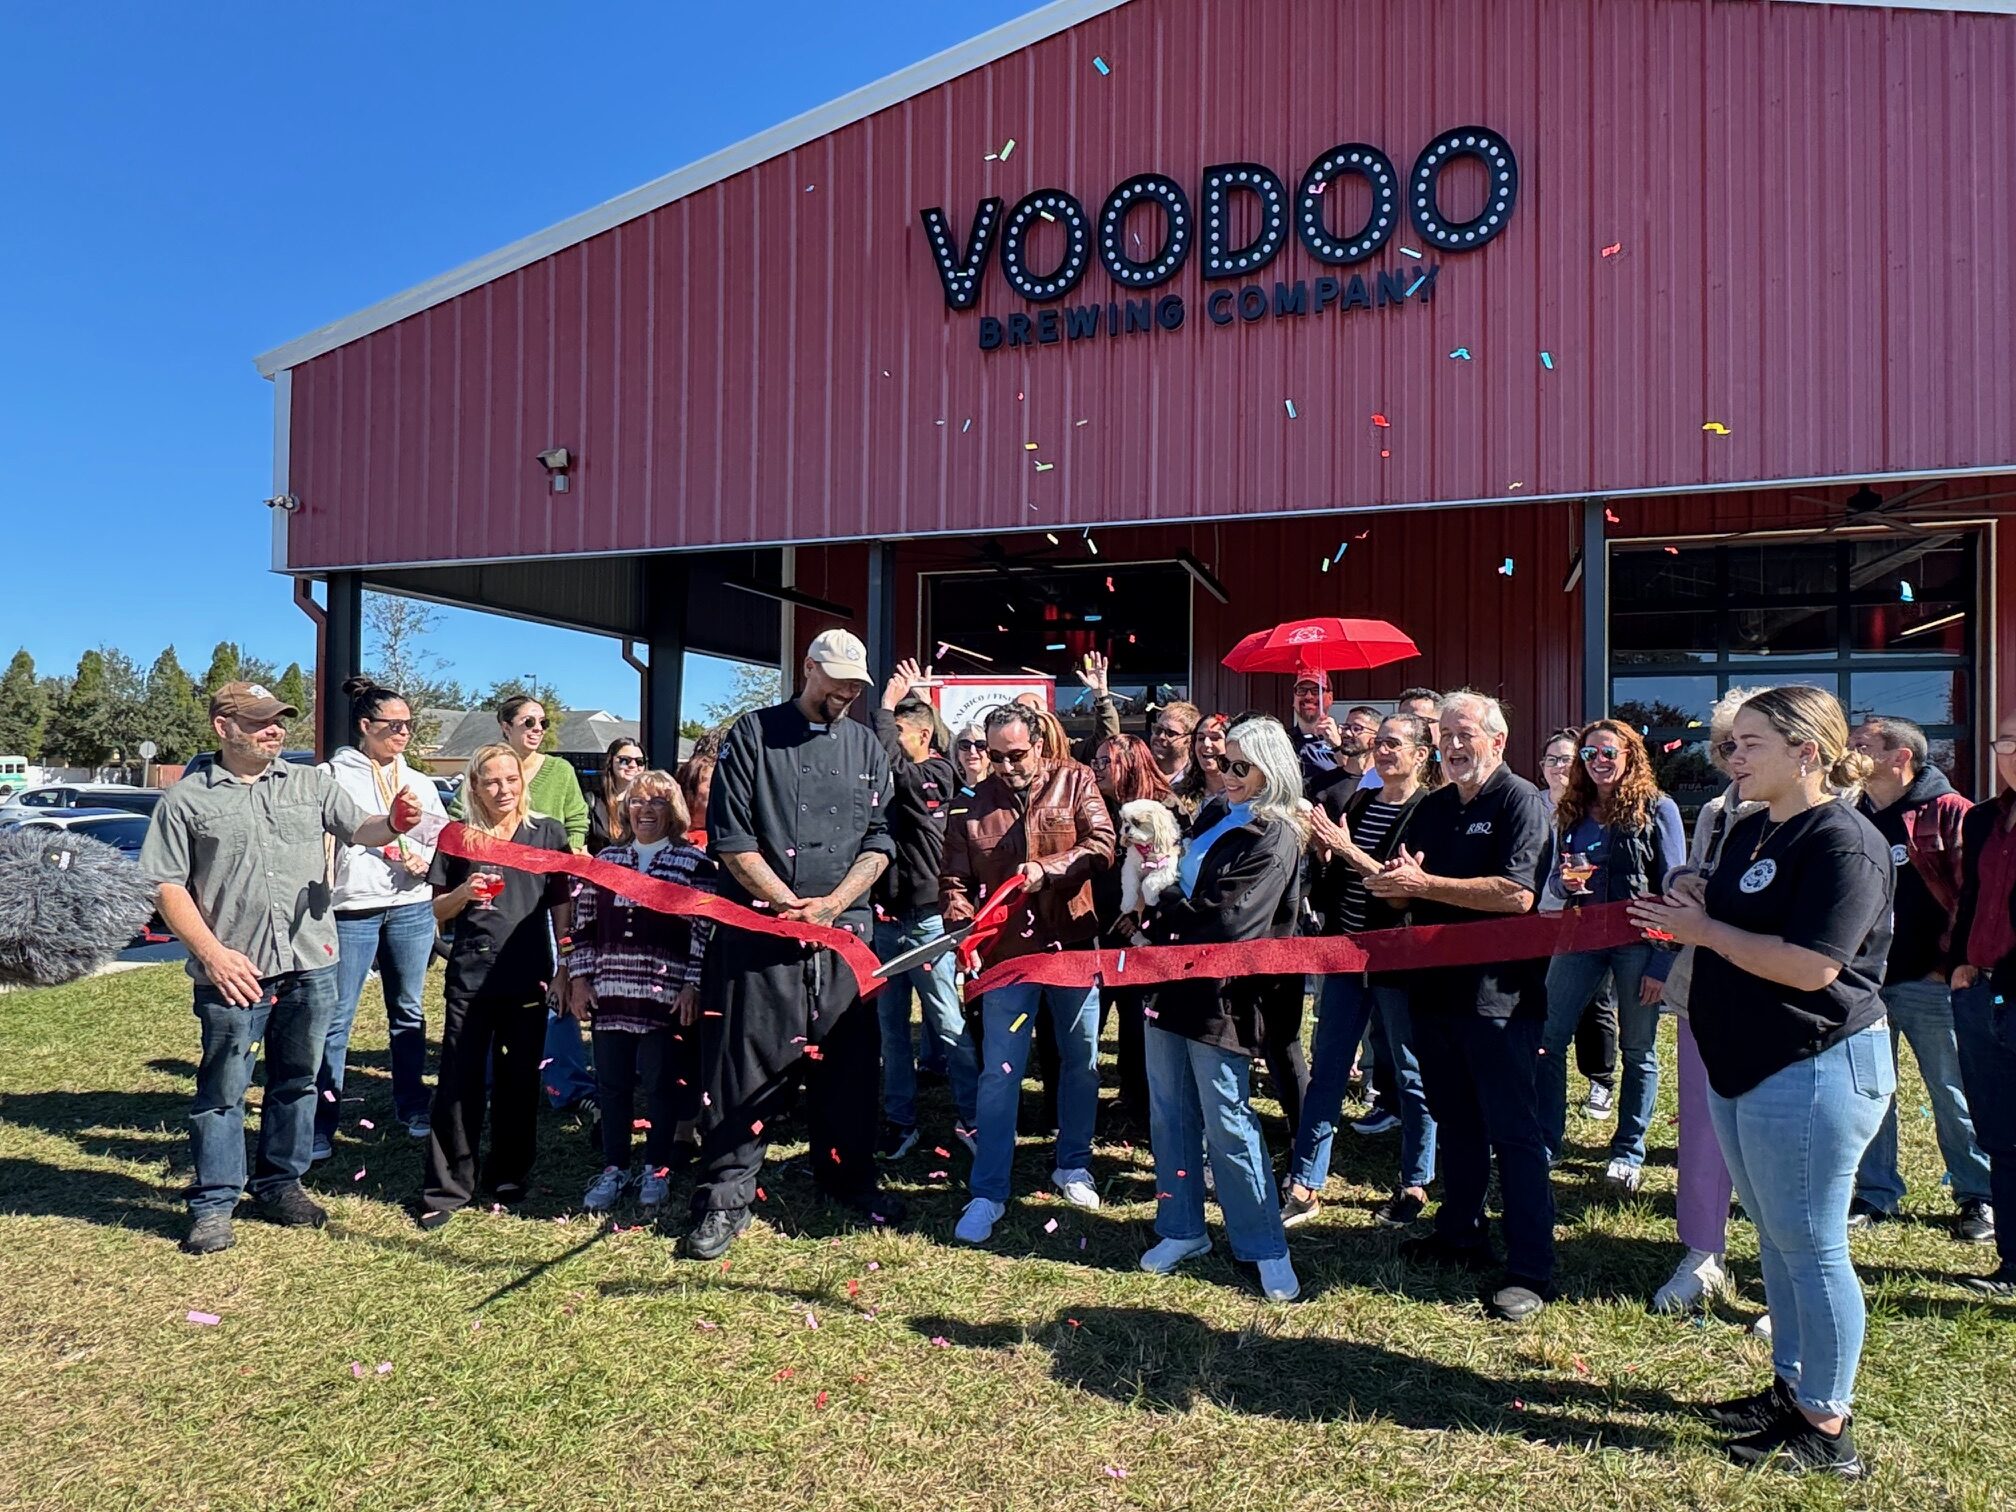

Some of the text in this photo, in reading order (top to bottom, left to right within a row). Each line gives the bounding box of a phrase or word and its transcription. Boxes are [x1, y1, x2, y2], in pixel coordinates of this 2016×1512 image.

[919, 126, 1519, 310] VOODOO
[979, 264, 1440, 350] BREWING COMPANY
[952, 695, 985, 725] VALRICO
